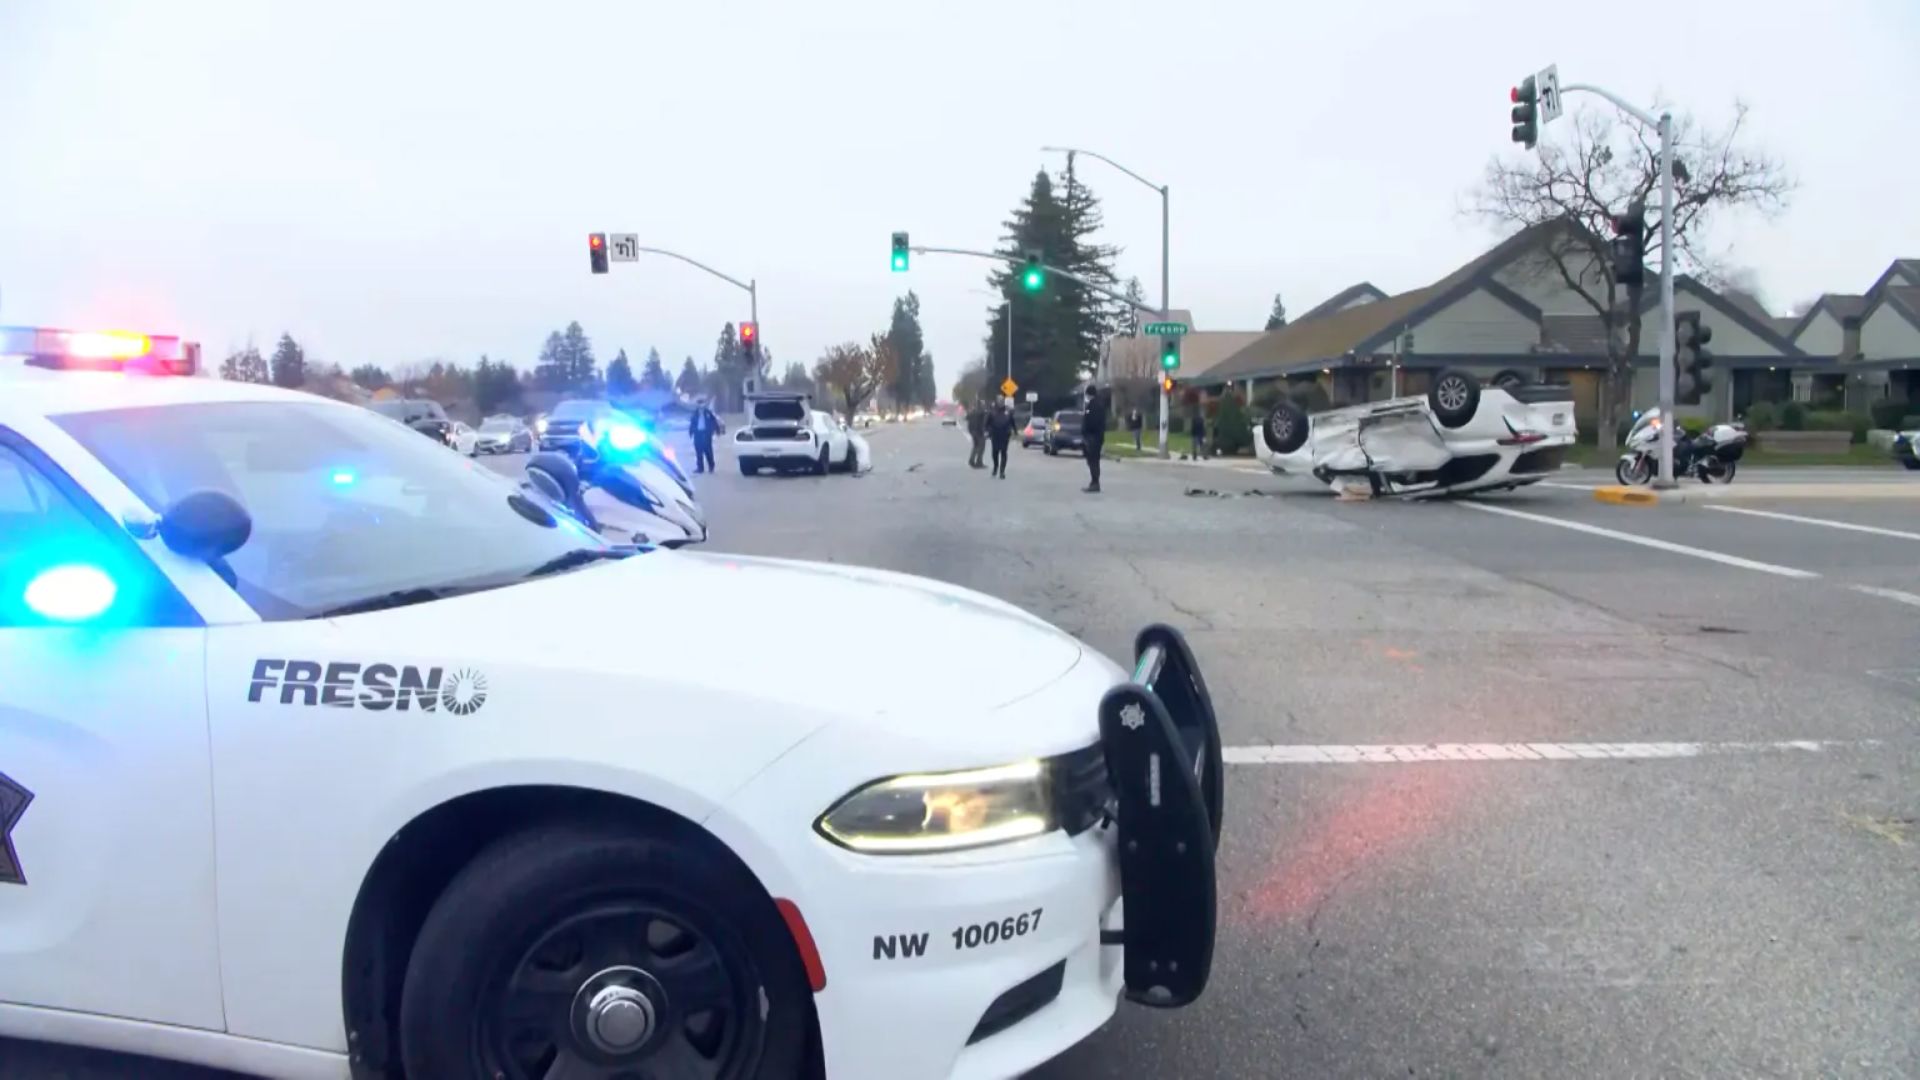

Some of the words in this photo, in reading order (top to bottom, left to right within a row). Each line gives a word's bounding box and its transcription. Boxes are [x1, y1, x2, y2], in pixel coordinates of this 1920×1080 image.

[248, 659, 488, 716] FRESNO
[873, 933, 929, 960] NW
[952, 907, 1043, 950] 100667
